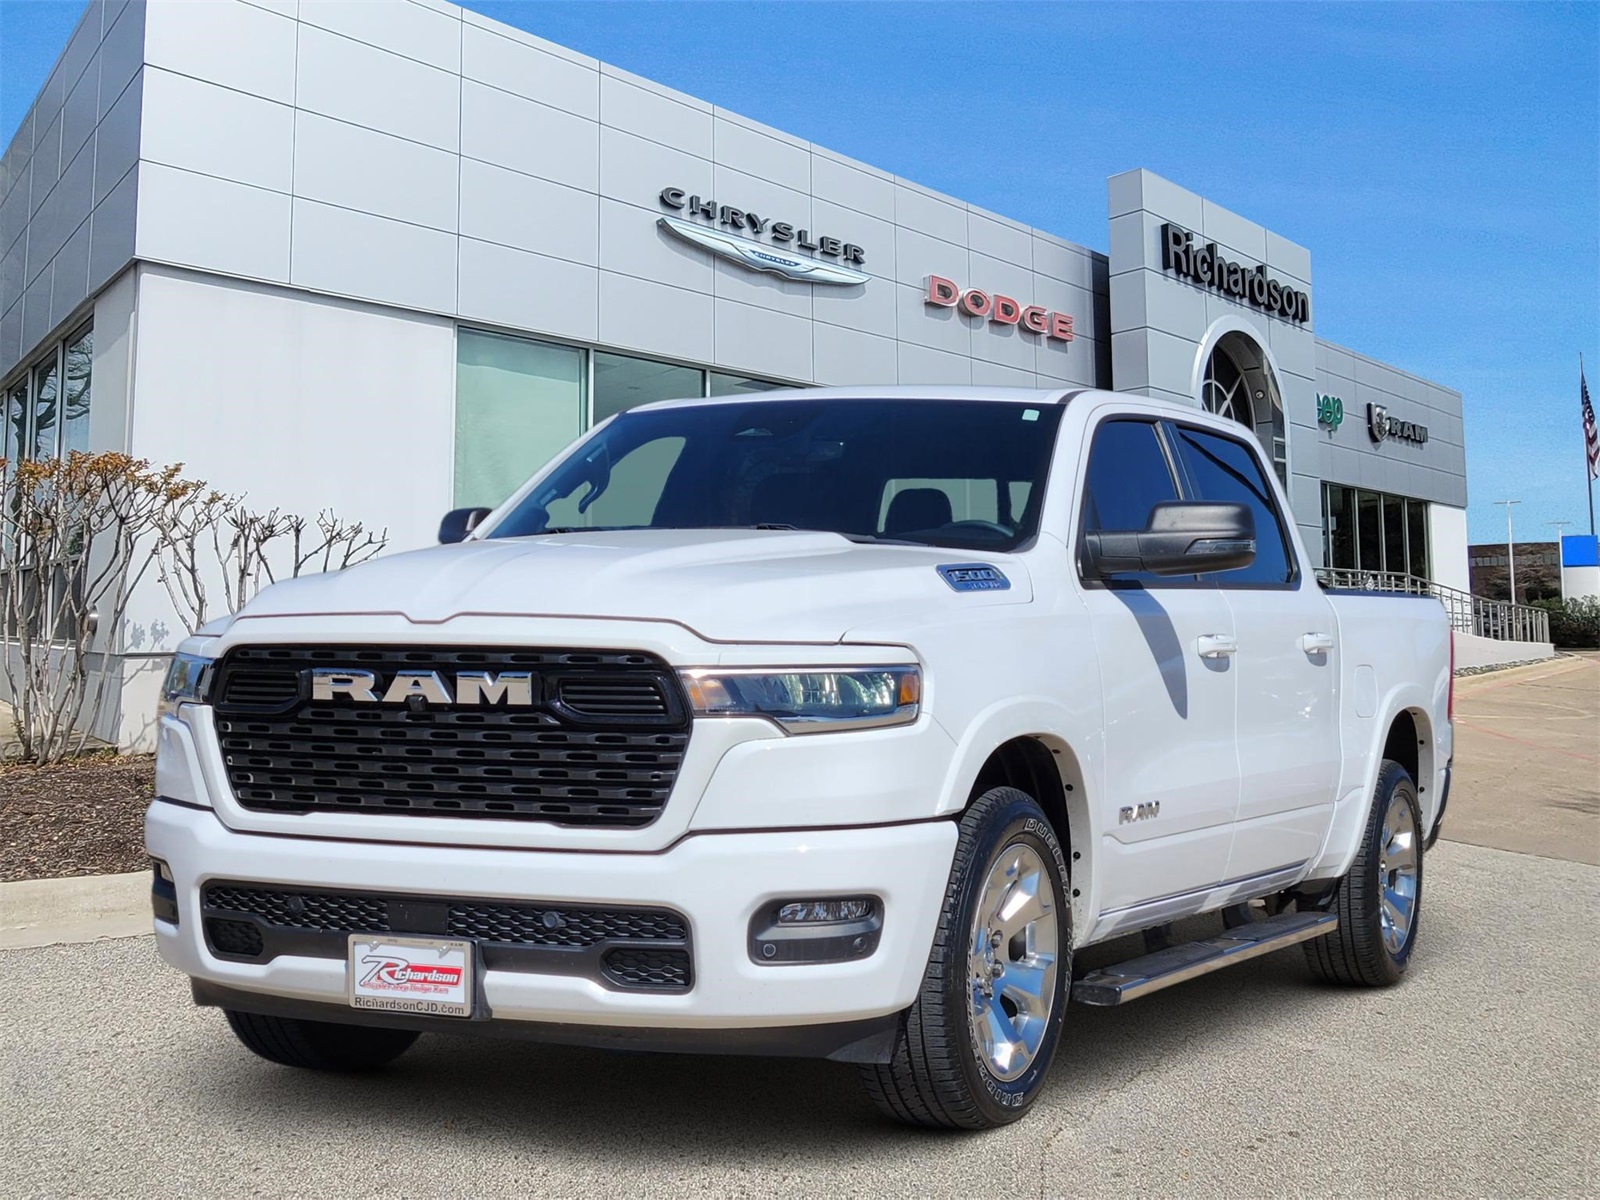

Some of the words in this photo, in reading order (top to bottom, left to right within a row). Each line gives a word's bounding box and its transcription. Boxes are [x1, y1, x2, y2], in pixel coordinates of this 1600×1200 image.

[660, 187, 866, 263] CHRYSLER
[1161, 223, 1310, 324] Richardson
[924, 275, 1074, 342] DODGE
[1386, 416, 1429, 443] RAM
[947, 569, 996, 582] 1500
[311, 667, 533, 705] RAM
[1119, 801, 1160, 825] RAM
[360, 954, 459, 987] Richardson
[354, 997, 465, 1015] RichardsonCJD.com
